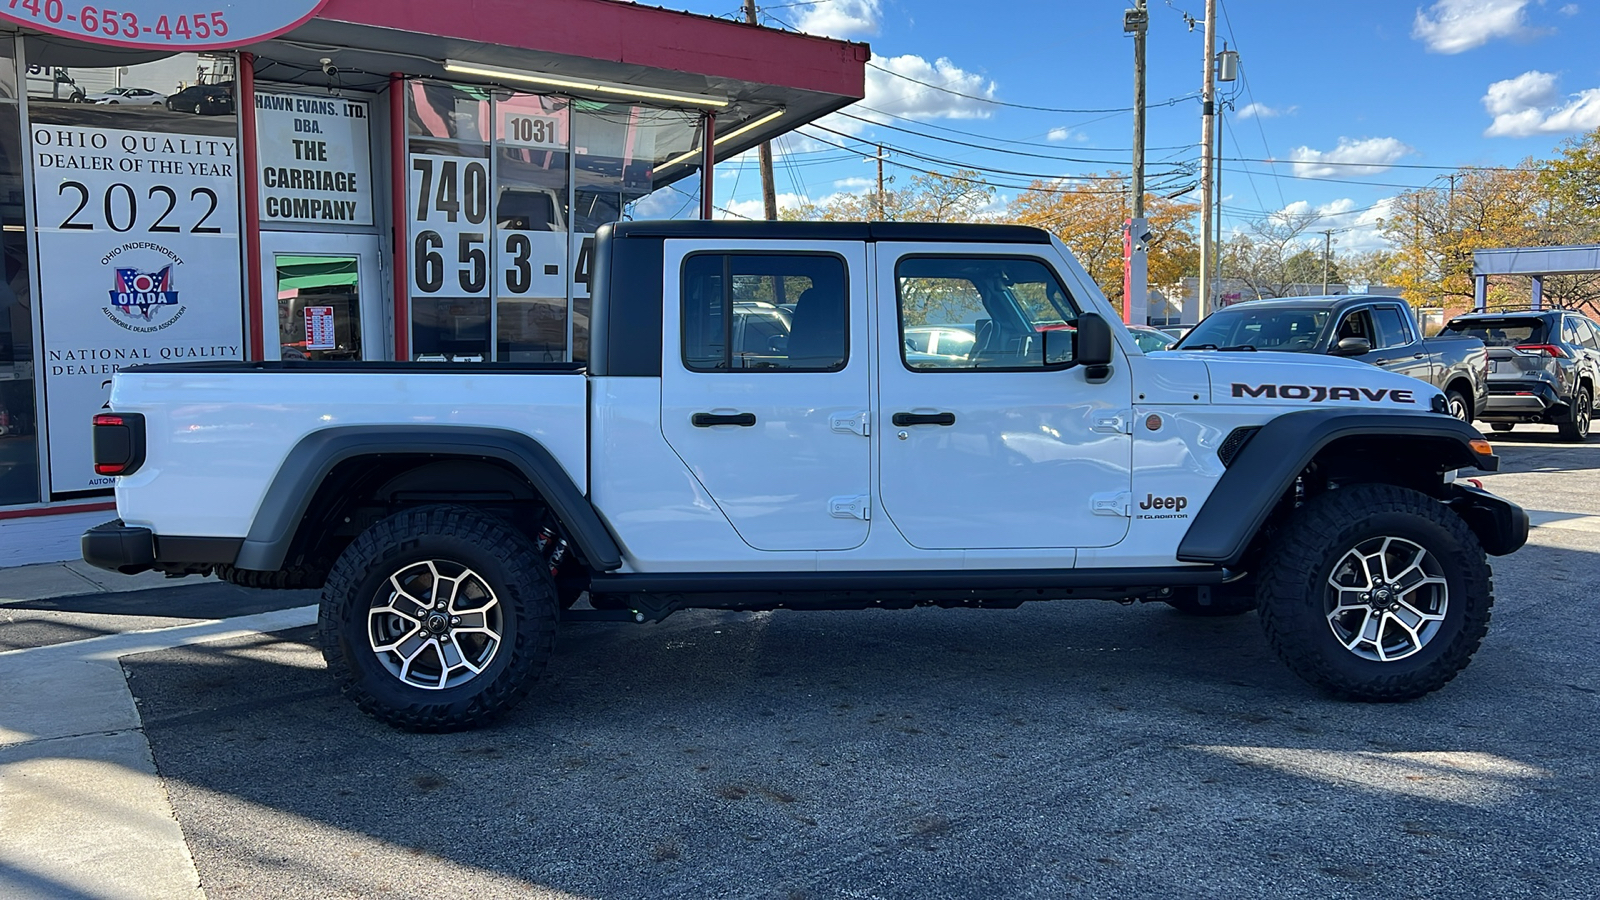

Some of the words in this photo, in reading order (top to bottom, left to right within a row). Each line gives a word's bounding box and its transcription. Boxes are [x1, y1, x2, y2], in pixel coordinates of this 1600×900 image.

[296, 99, 339, 116] EVANS.
[343, 103, 367, 119] LTD.
[293, 118, 323, 134] DBA.
[510, 117, 555, 144] 1031
[34, 129, 107, 149] OHIO
[121, 135, 235, 157] QUALITY
[292, 139, 328, 162] THE
[39, 153, 115, 171] DEALER
[119, 158, 143, 173] OF
[147, 160, 184, 175] THE
[188, 162, 233, 177] YEAR
[263, 166, 358, 193] CARRIAGE
[413, 158, 487, 225] 740
[58, 180, 222, 234] 2022
[265, 196, 358, 221] COMPANY
[101, 247, 122, 266] OHIO
[122, 241, 185, 266] INDEPENDENT
[118, 292, 168, 305] OIADA
[102, 306, 132, 331] AUTOMOBILE
[133, 324, 158, 333] DEALERS
[158, 305, 187, 331] ASSOCIATION
[50, 347, 151, 361] NATIONAL
[160, 346, 239, 359] QUALITY
[53, 363, 120, 375] DEALER
[1231, 383, 1415, 404] MOJAVE
[1139, 493, 1188, 512] Jeep
